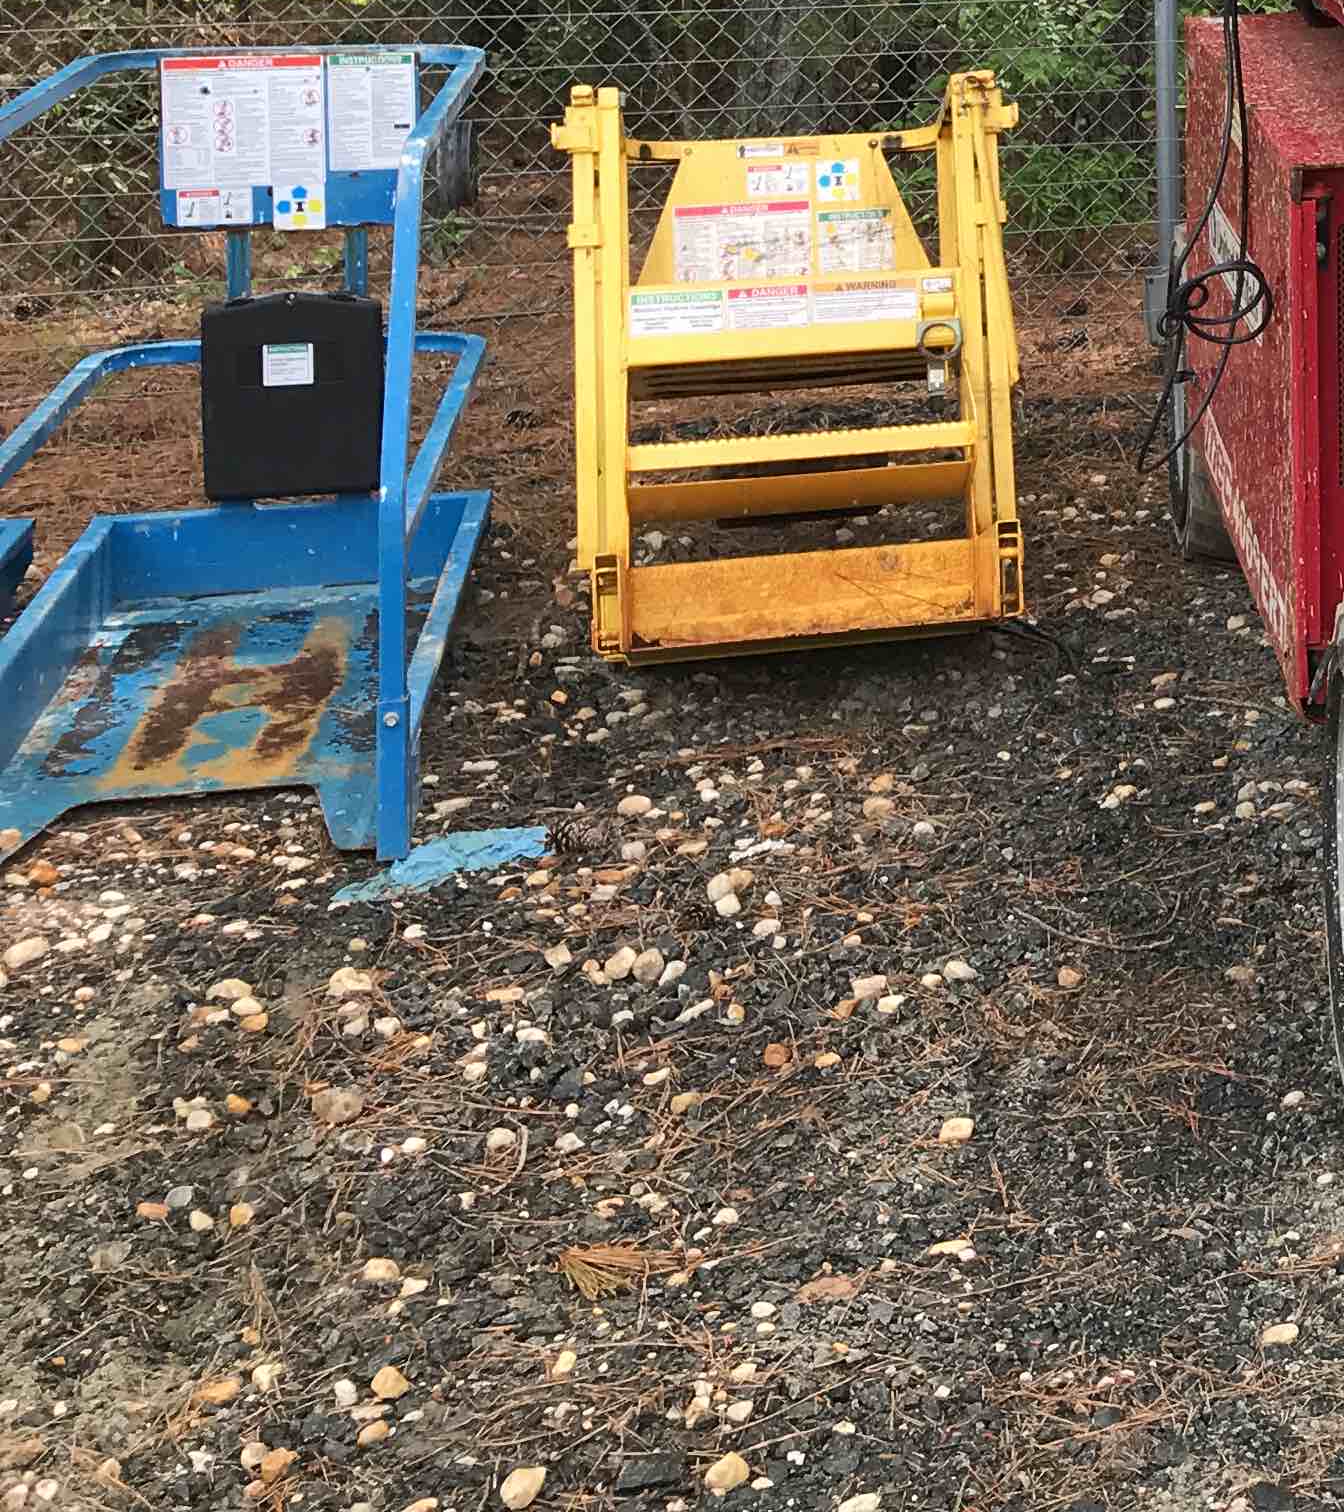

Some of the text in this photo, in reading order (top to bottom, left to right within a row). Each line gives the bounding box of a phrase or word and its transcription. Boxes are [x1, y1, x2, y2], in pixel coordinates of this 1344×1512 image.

[227, 57, 273, 68] DANGER
[338, 55, 403, 65] INSTRUCTIONS
[730, 204, 769, 214] DANGER
[845, 279, 897, 290] WARNING
[751, 286, 798, 297] DANGER
